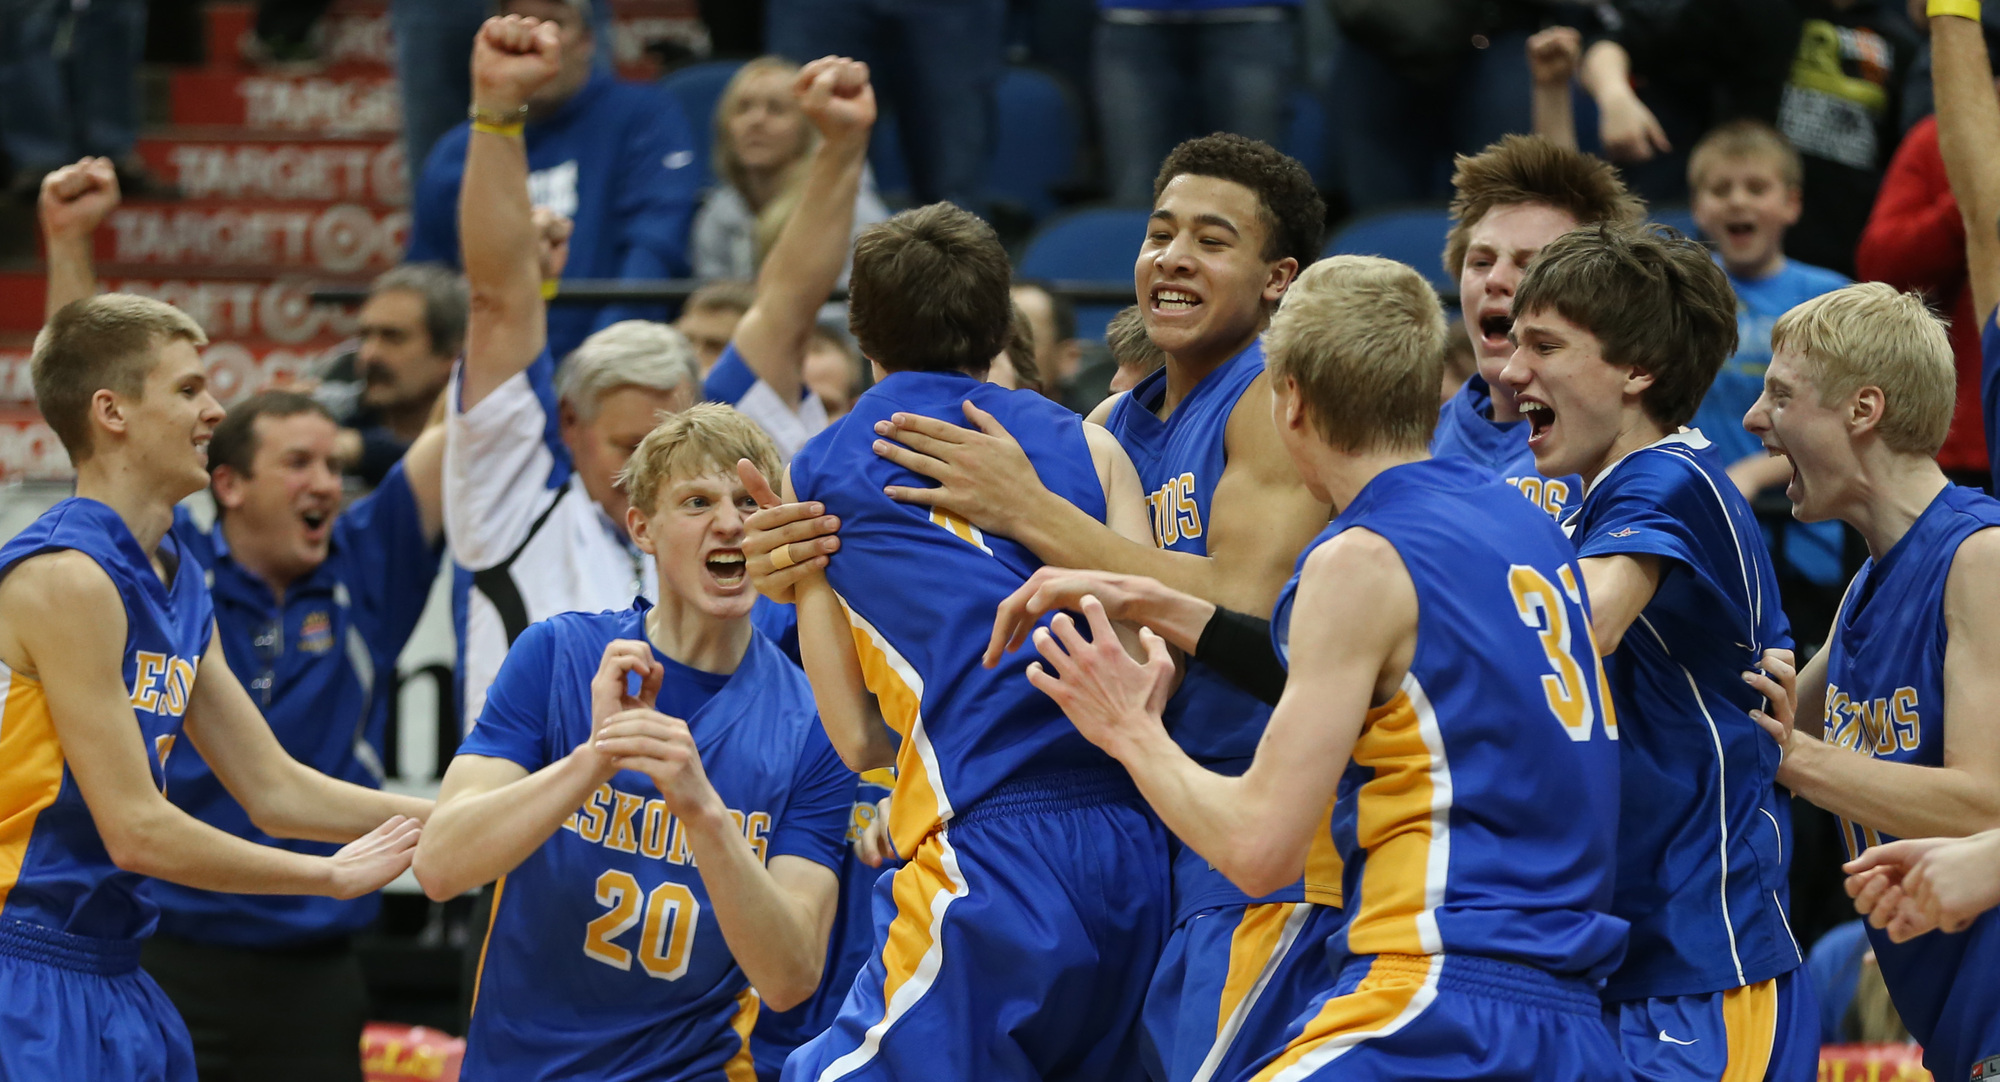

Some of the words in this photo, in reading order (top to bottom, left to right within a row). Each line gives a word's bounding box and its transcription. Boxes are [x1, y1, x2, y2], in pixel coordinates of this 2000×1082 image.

[172, 147, 368, 198] TARGET
[114, 209, 309, 262] TARGET
[584, 868, 701, 982] 20
